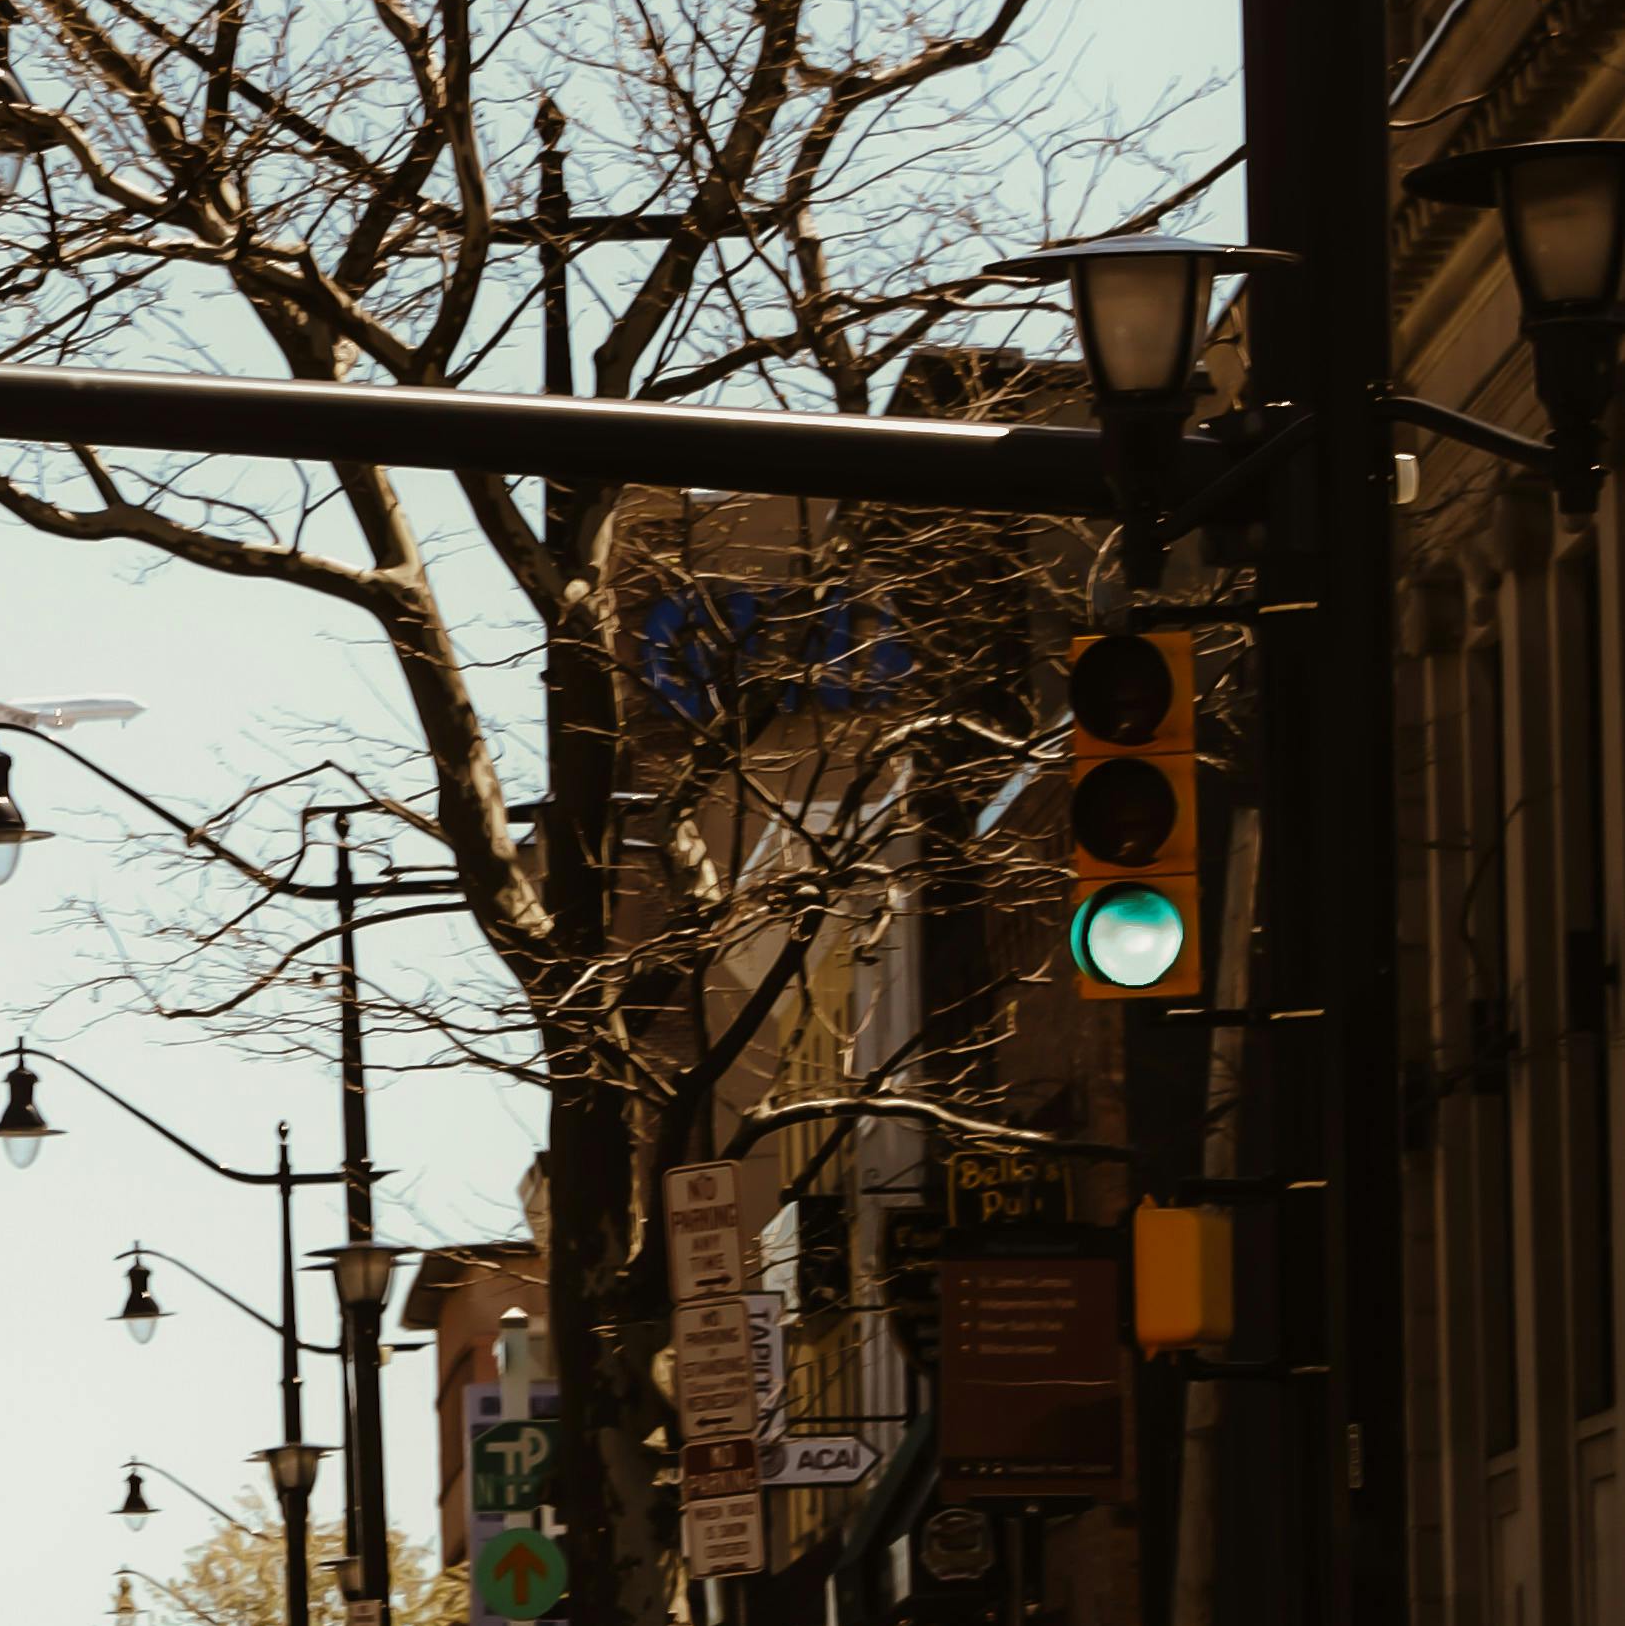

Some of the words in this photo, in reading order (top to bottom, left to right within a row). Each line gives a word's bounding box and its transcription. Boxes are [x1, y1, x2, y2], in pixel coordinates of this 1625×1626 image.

[688, 1175, 717, 1202] NO
[671, 1205, 738, 1233] PARKING
[709, 1444, 737, 1468] NO
[688, 1468, 757, 1497] PARKING
